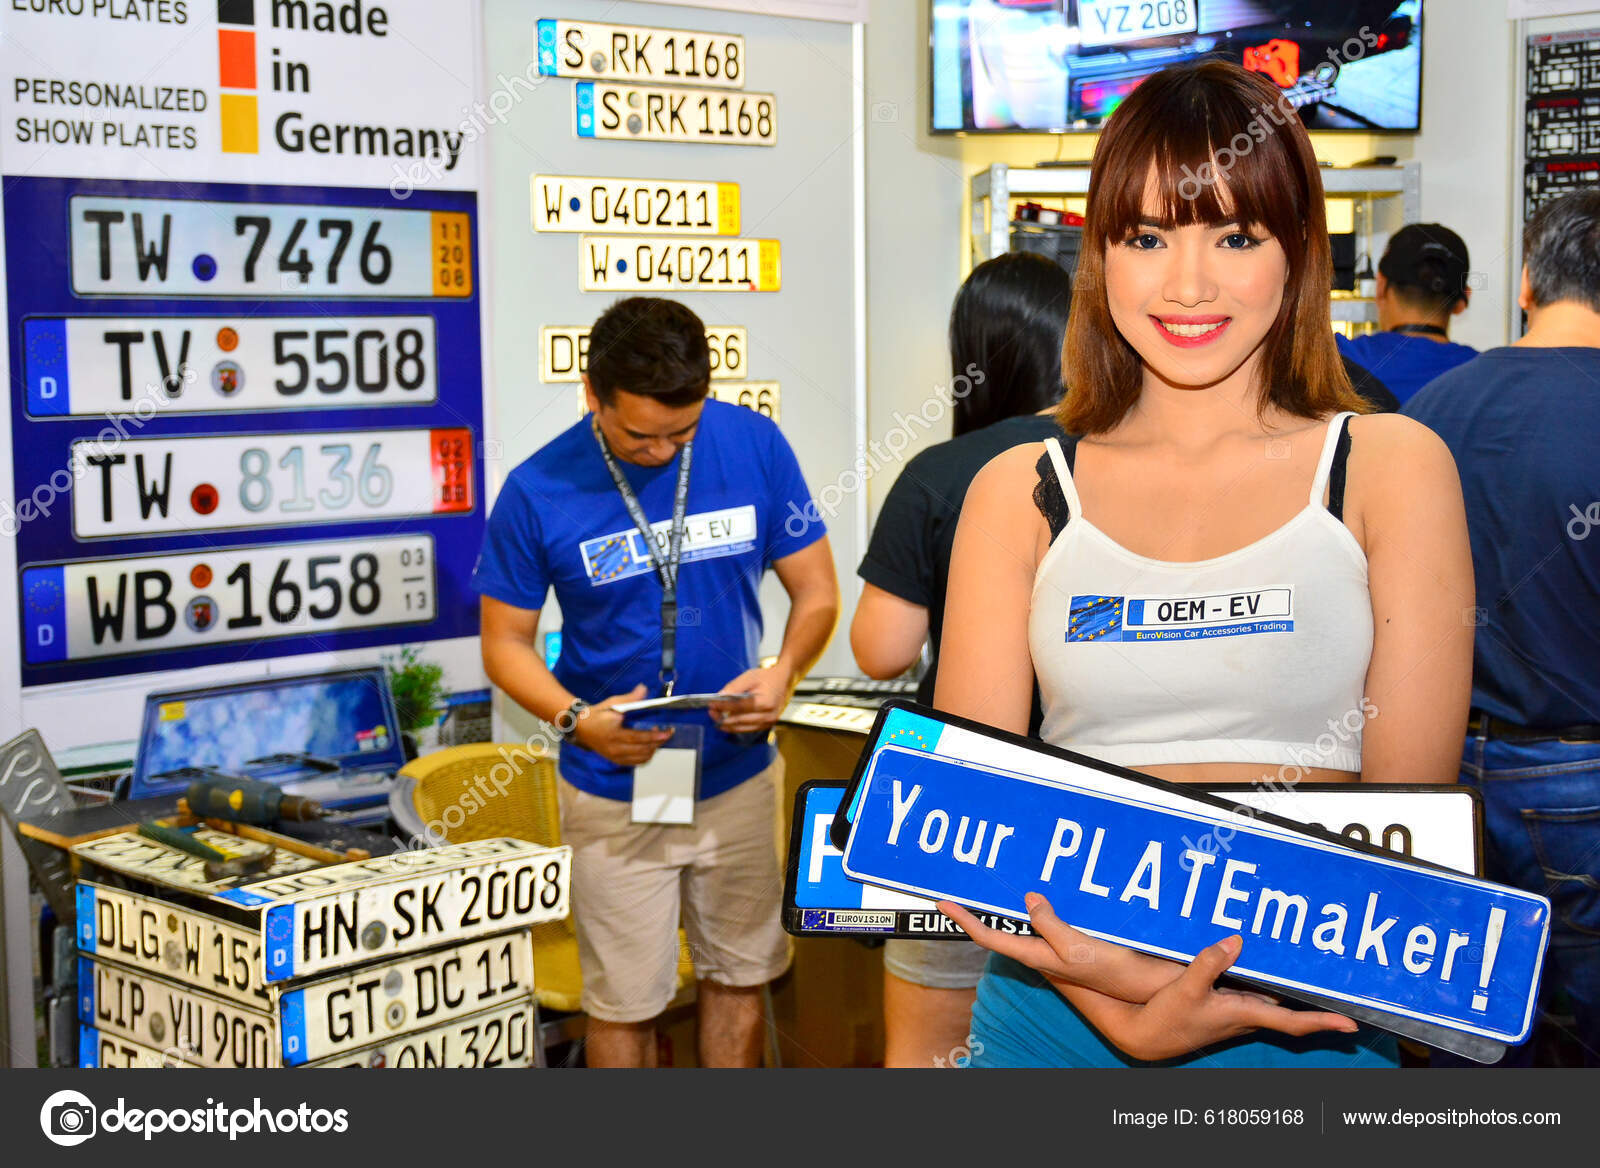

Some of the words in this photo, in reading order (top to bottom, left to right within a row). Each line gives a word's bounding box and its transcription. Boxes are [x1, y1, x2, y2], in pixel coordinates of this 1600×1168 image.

[93, 0, 188, 25] PLATES
[271, 0, 389, 37] made
[1096, 7, 1132, 35] YZ
[1142, 0, 1190, 30] 208
[272, 48, 311, 93] in
[564, 29, 584, 69] S
[611, 32, 652, 75] RK
[664, 37, 740, 81] 1168
[14, 78, 208, 112] PERSONALIZED
[602, 91, 621, 131] S
[647, 94, 687, 134] RK
[698, 97, 772, 138] 1168
[16, 118, 94, 145] SHOW
[103, 122, 197, 150] PLATES
[274, 111, 466, 170] Germany
[543, 184, 563, 223] W
[591, 186, 712, 228] 040211
[83, 210, 172, 282] TW
[235, 216, 393, 285] 7476
[591, 244, 609, 282] W
[636, 245, 752, 284] 040211
[103, 330, 192, 400] TV
[273, 328, 425, 396] 5508
[86, 452, 173, 523] TW
[238, 443, 394, 513] 8136
[655, 526, 691, 549] OM
[86, 570, 177, 646] WB
[226, 553, 381, 630] 1658
[1157, 600, 1206, 622] OEM
[1230, 594, 1262, 617] EV
[1136, 631, 1183, 640] EuroVision
[1184, 630, 1200, 638] Car
[1202, 626, 1252, 637] Accessories
[1254, 622, 1287, 633] Trading
[303, 900, 357, 962] HN
[393, 882, 444, 940] SK
[460, 862, 560, 927] 2008
[836, 914, 892, 924] EUROVISION
[886, 780, 1014, 869] Your
[1040, 818, 1507, 1011] PLATEmaker!
[98, 898, 160, 961] DLG
[184, 919, 201, 976] W
[98, 968, 144, 1032] LIP
[327, 980, 380, 1042] GT
[415, 958, 464, 1018] DC
[477, 943, 518, 1000] 11
[460, 1012, 526, 1068] 320
